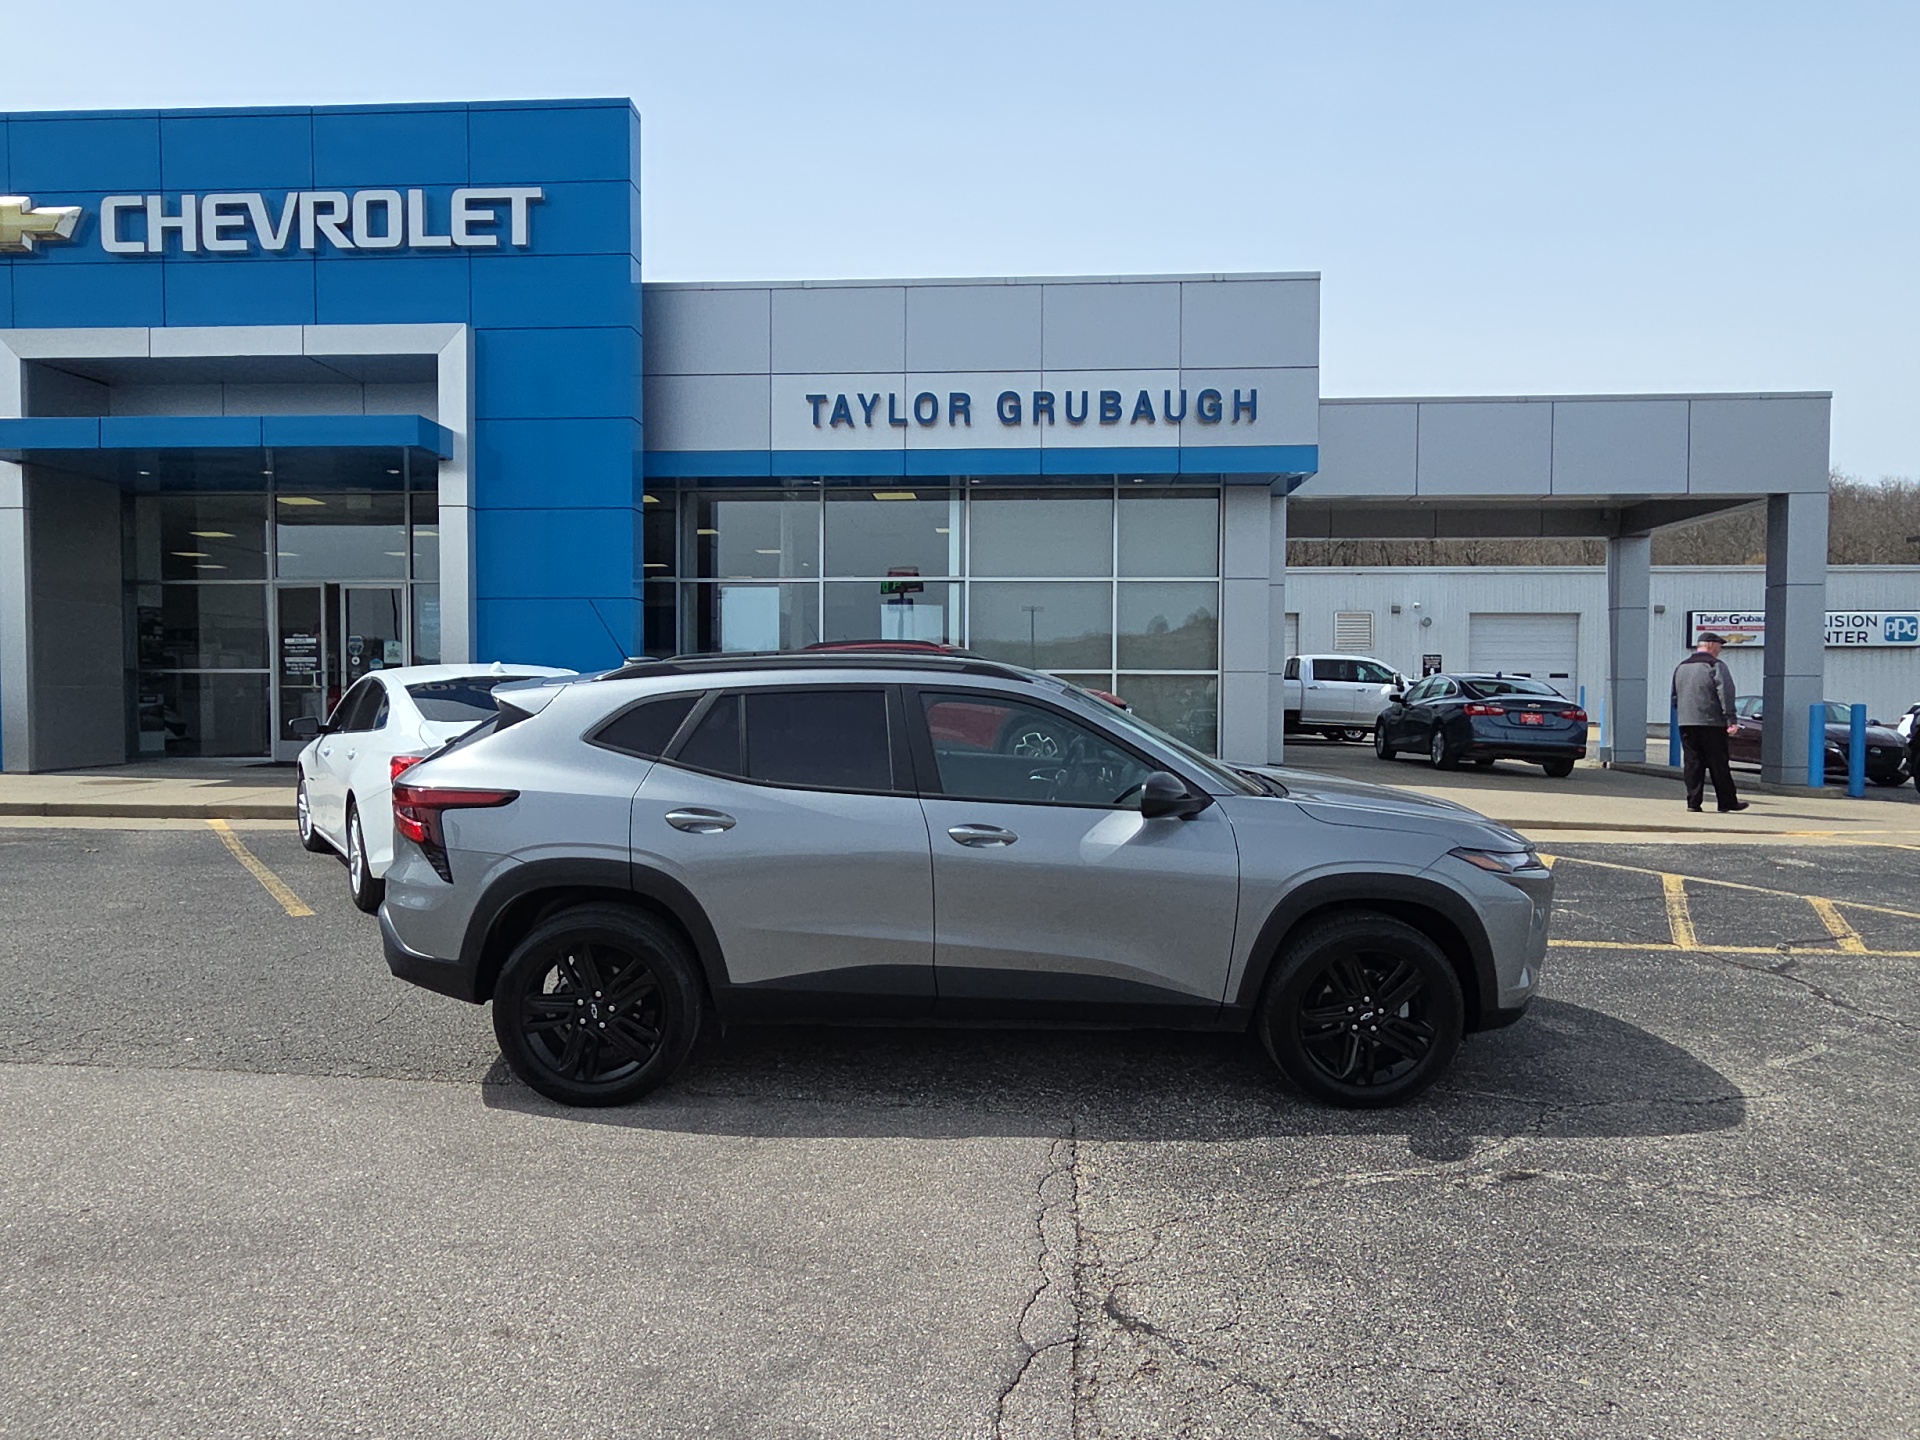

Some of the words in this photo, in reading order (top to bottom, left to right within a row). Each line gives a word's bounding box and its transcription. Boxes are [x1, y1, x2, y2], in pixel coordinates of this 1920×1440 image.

[100, 187, 543, 253] CHEVROLET
[805, 391, 972, 428] TAYLOR
[996, 388, 1258, 426] GRUBAUGH
[1696, 613, 1728, 625] Taylor
[1824, 615, 1878, 628] ISION
